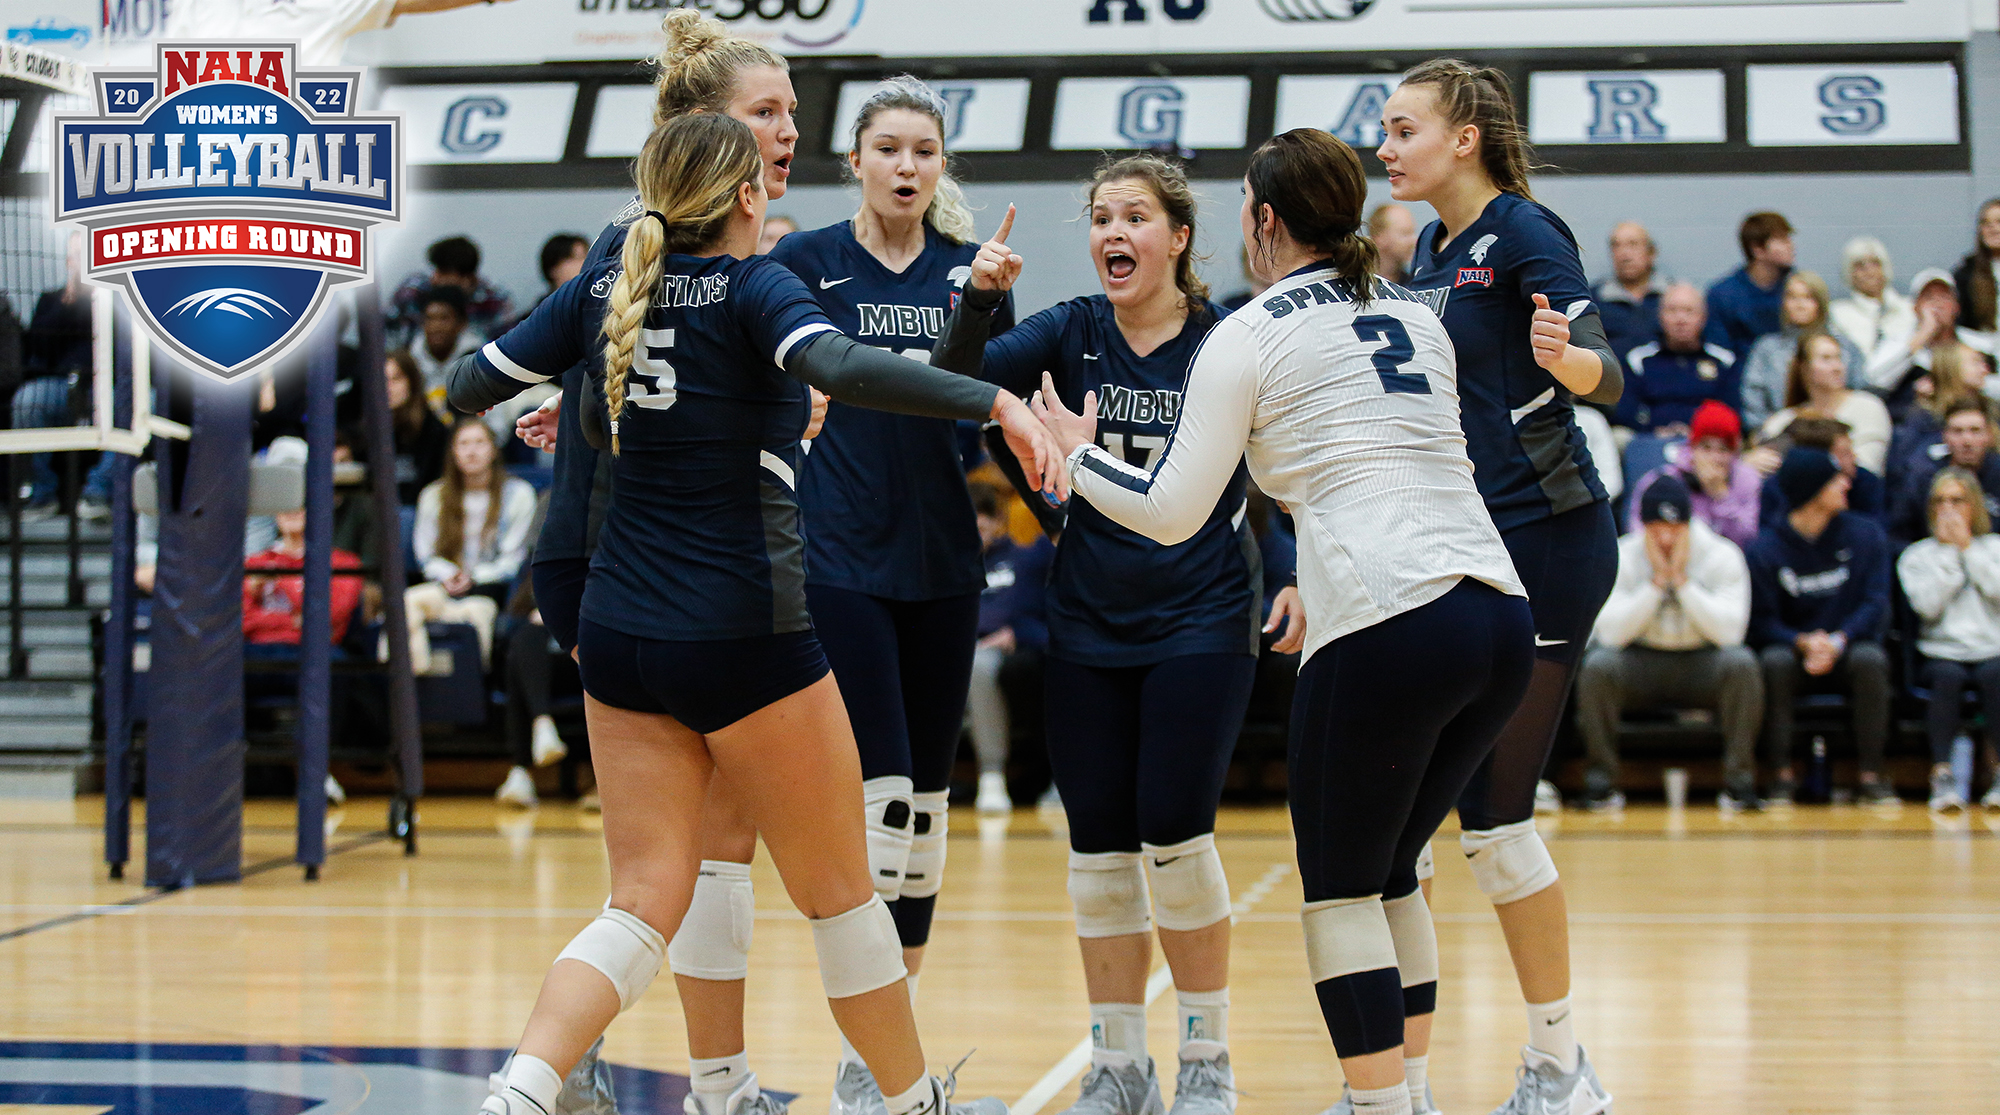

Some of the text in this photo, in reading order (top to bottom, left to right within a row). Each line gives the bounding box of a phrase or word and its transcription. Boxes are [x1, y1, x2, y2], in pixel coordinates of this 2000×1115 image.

[1457, 270, 1493, 286] NAIA
[857, 303, 945, 340] MBU
[626, 328, 678, 411] 5
[1351, 313, 1433, 395] 2
[1097, 383, 1182, 425] MBU
